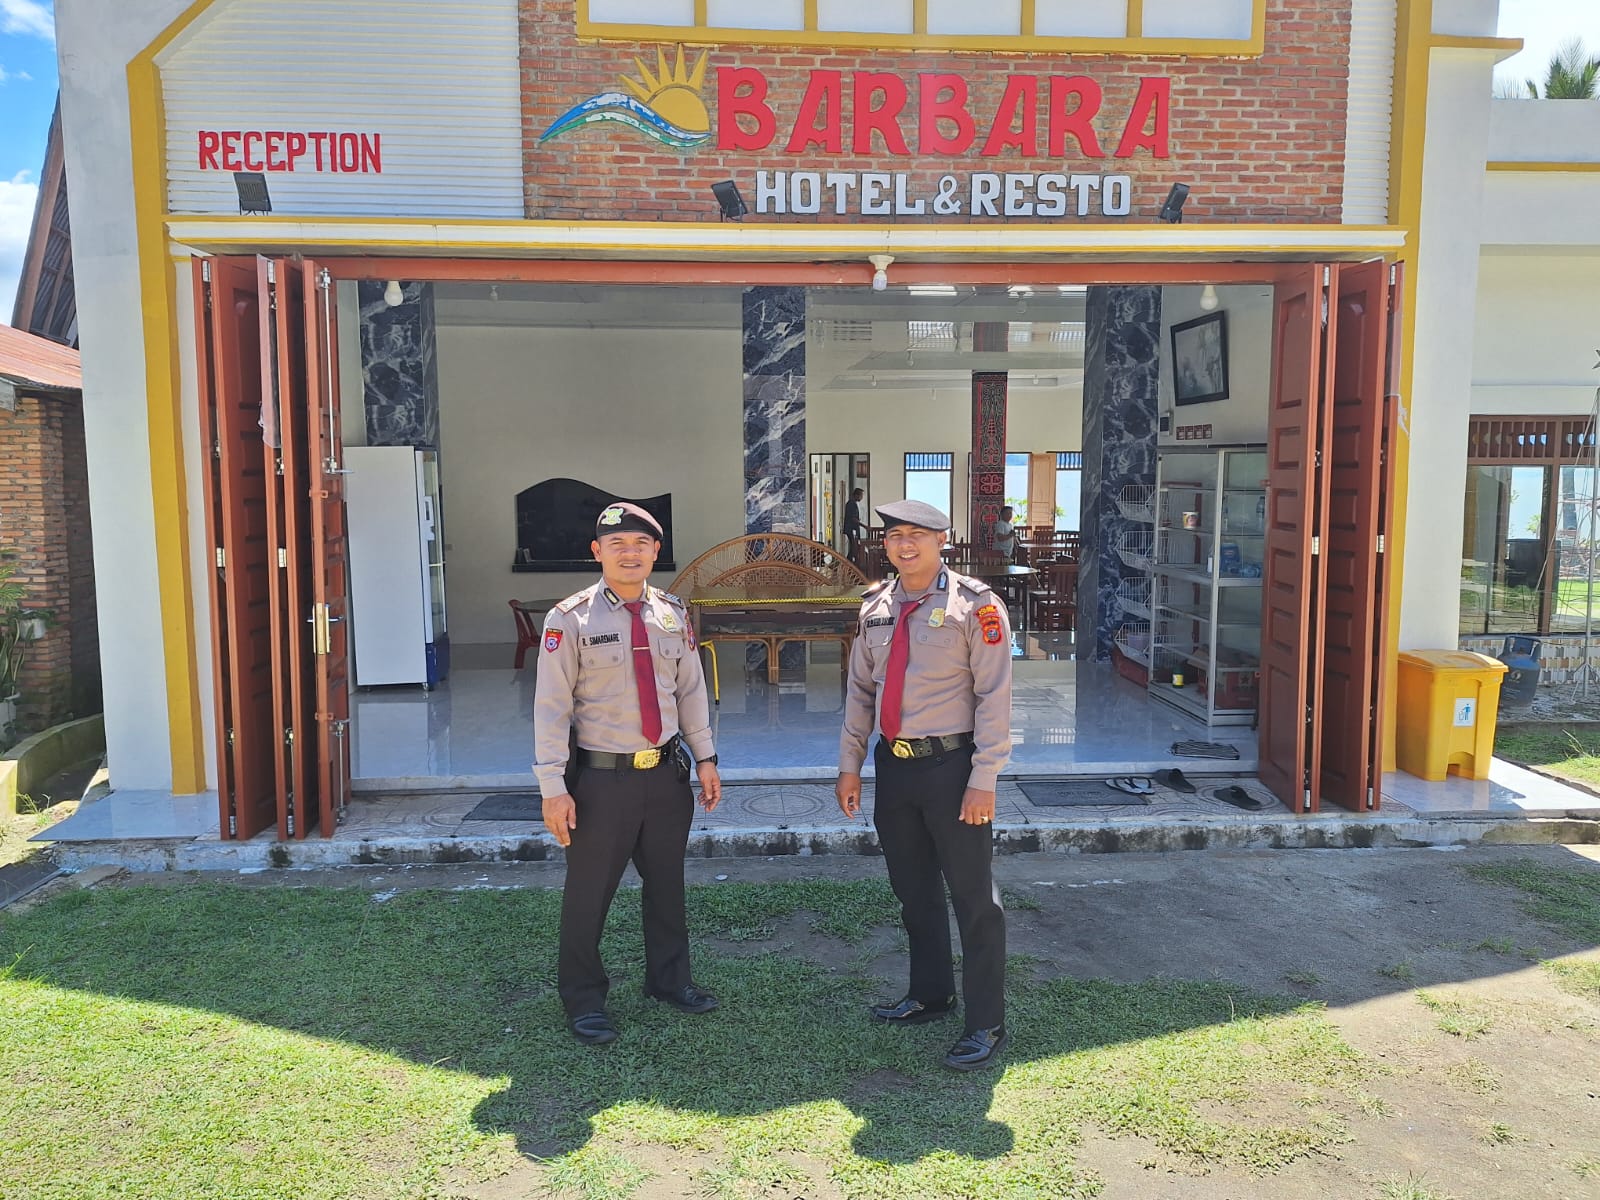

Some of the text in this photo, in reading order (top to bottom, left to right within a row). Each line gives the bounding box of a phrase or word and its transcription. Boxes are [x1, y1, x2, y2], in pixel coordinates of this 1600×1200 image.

[716, 66, 1170, 158] BARBARA
[198, 130, 381, 173] RECEPTION
[756, 170, 1131, 217] HOTEL & RESTO
